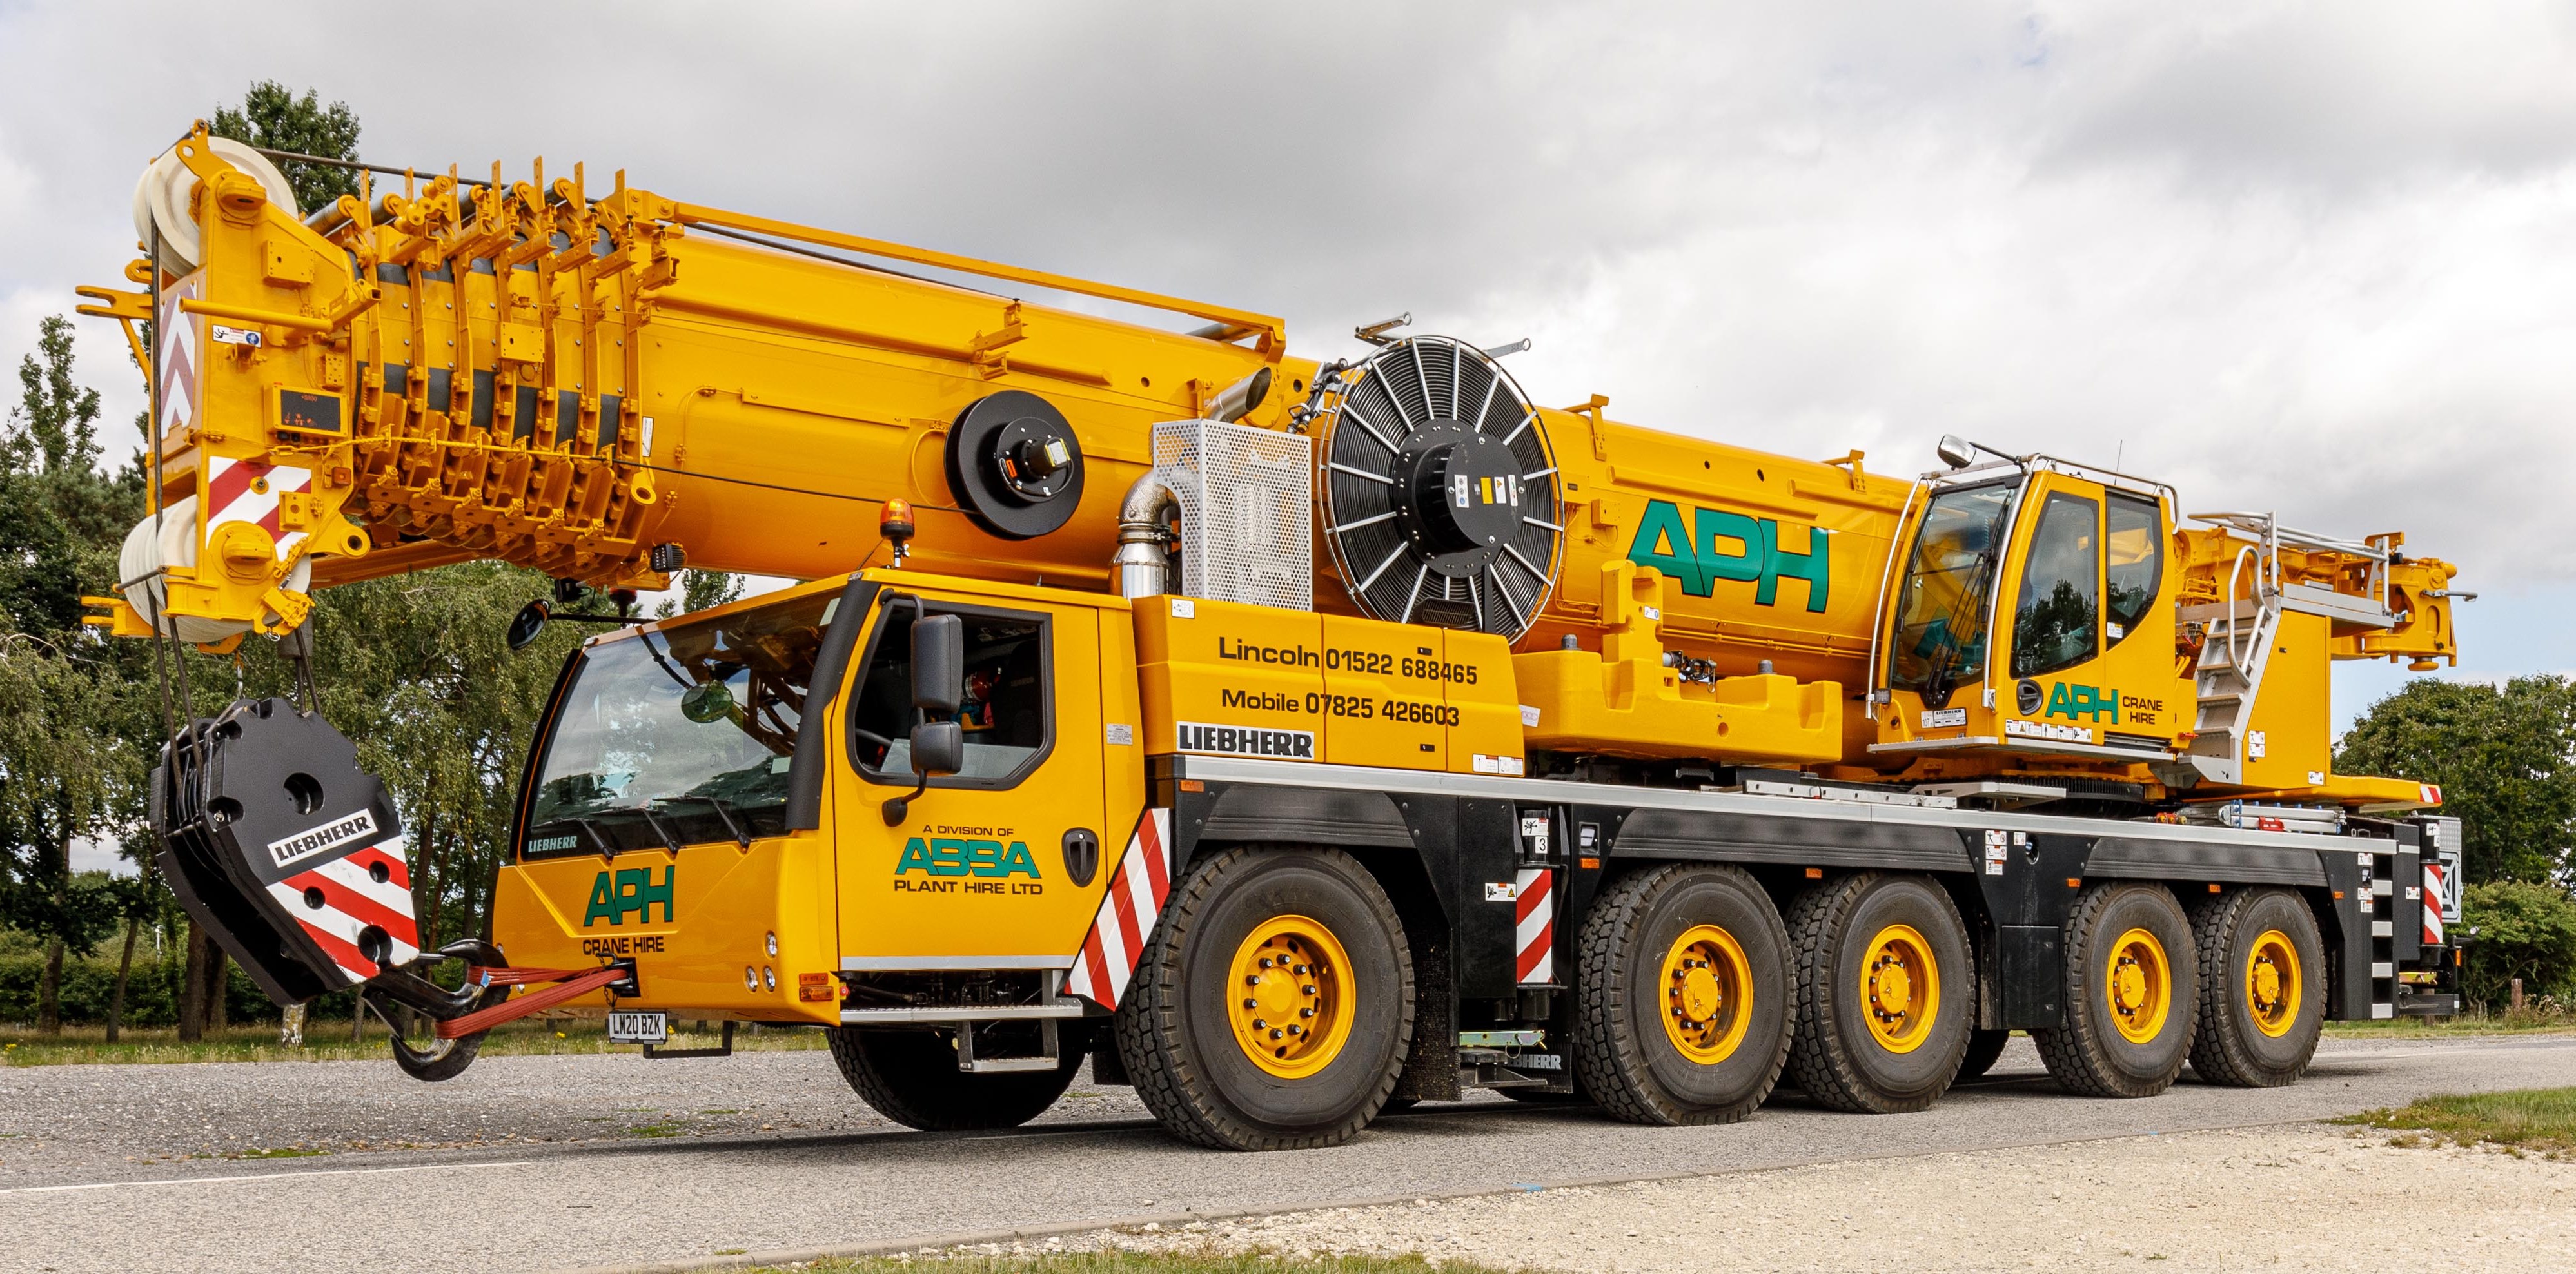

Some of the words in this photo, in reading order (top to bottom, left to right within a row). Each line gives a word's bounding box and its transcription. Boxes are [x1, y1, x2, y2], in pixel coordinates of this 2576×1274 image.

[1626, 498, 1830, 614] APH
[1219, 636, 1320, 669] Lincoln
[1326, 648, 1393, 675] 01522
[1402, 658, 1478, 685] 688465
[1221, 688, 1299, 712] Mobile
[1305, 692, 1373, 718] 07825
[1381, 700, 1460, 727] 426603
[2045, 681, 2119, 725] APH
[2122, 696, 2163, 712] CRANE
[2129, 711, 2156, 725] HIRE
[1179, 724, 1312, 758] LIEBHERR
[275, 816, 372, 861] LIEBHERR
[528, 835, 577, 852] LIEBHERR
[923, 825, 932, 834] A
[937, 825, 993, 836] DIVISION
[998, 827, 1014, 836] OF
[894, 837, 1041, 879] ABBA
[1539, 838, 1546, 851] 3
[583, 865, 674, 927] APH
[894, 880, 958, 894] PLANT
[964, 881, 1005, 894] HIRE
[1012, 883, 1043, 895] LTD
[583, 937, 629, 956] CRANE
[633, 936, 664, 954] HIRE
[613, 1015, 638, 1034] LM20
[641, 1015, 661, 1035] BZK
[1506, 1054, 1562, 1070] EBHERR
